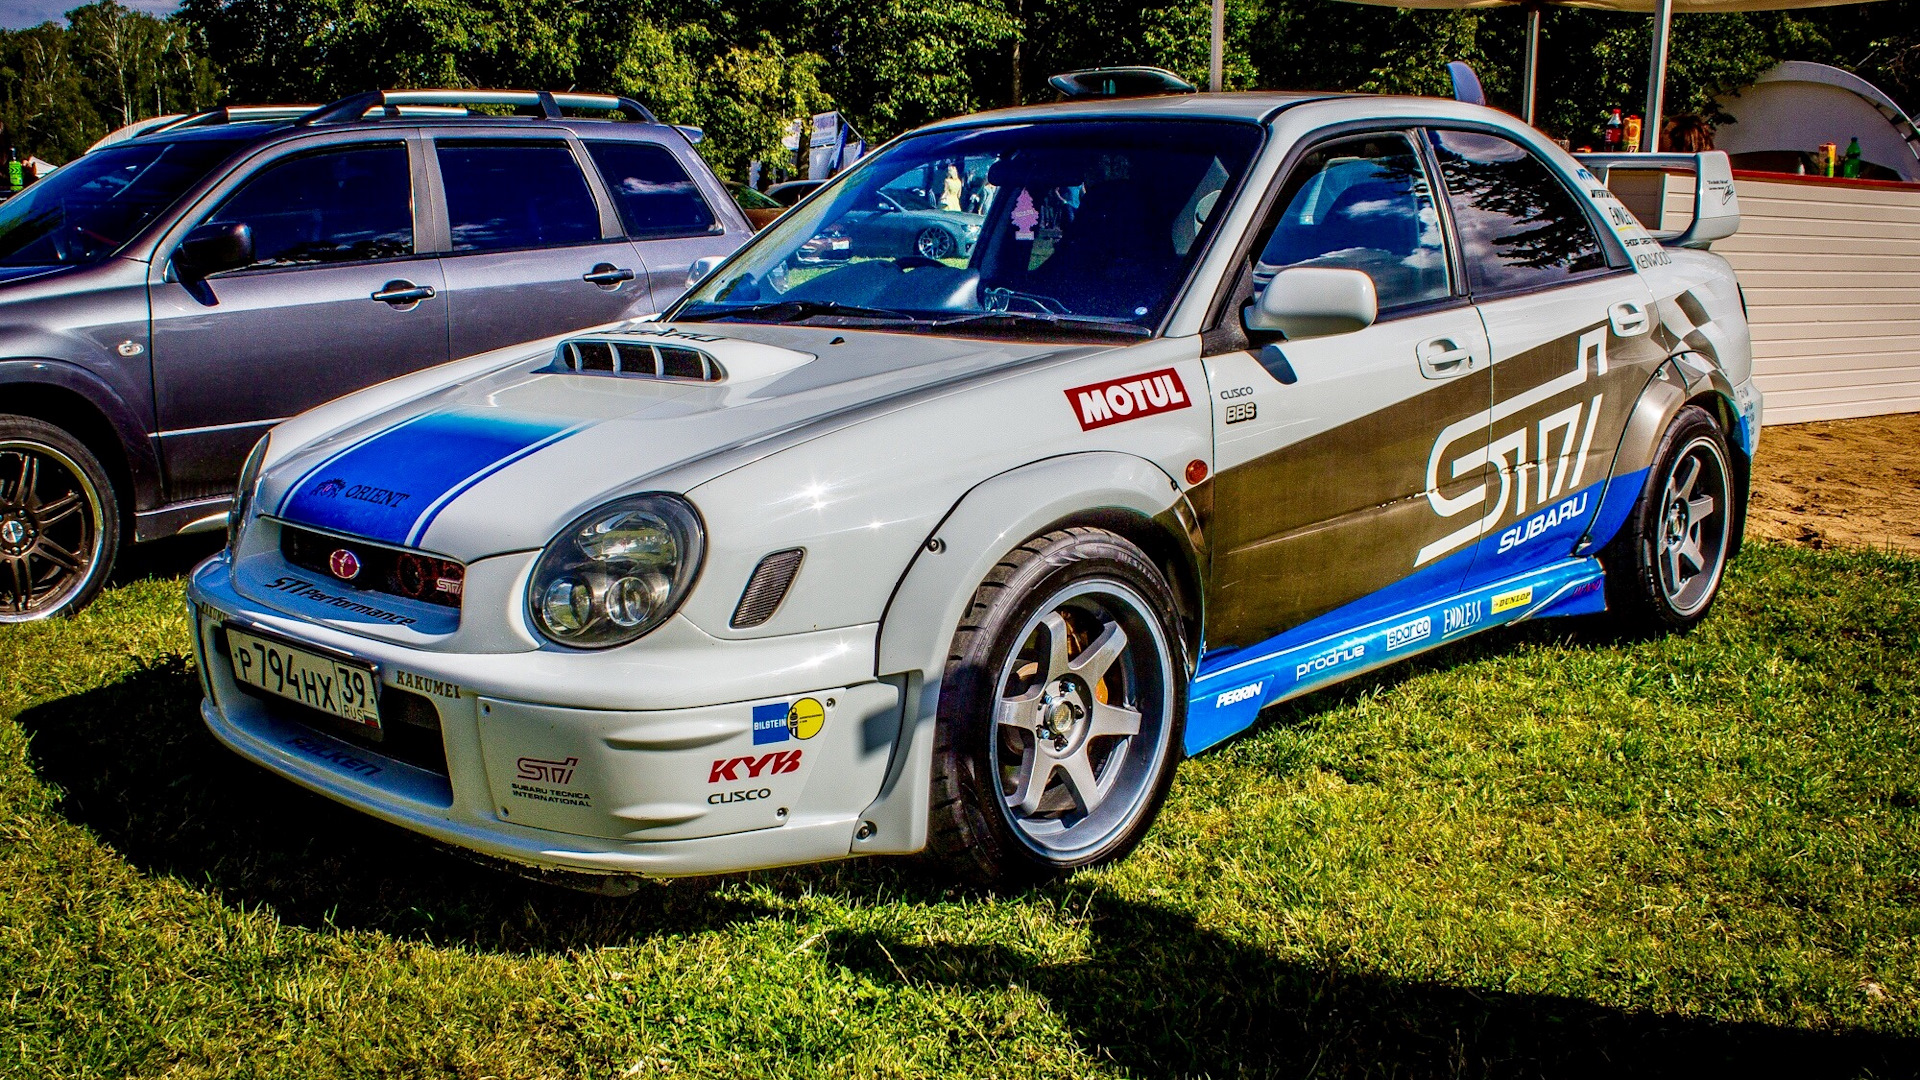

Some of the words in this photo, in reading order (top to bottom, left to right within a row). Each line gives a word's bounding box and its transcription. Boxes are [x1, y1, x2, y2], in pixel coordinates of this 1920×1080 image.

[1634, 252, 1672, 270] KENWOOD
[1078, 374, 1185, 425] MOTUL
[1220, 386, 1254, 400] CUSCO
[1225, 402, 1257, 424] BBS
[345, 484, 411, 508] ORIENT
[1497, 492, 1588, 554] SUBARU
[1499, 591, 1532, 607] DUNLOP
[1443, 599, 1482, 634] ENDLESS
[1388, 619, 1430, 647] sparco
[1296, 645, 1365, 682] prodrive
[396, 670, 462, 699] KAKUMEI
[1215, 681, 1263, 708] PERRIN
[343, 705, 364, 722] RUS
[753, 718, 787, 732] BILSTEIN
[707, 749, 803, 784] KYB
[511, 782, 549, 795] SUBARU
[549, 788, 592, 800] TECNICA
[512, 790, 593, 808] INTERNATIONAL
[707, 787, 772, 806] CUSCO
